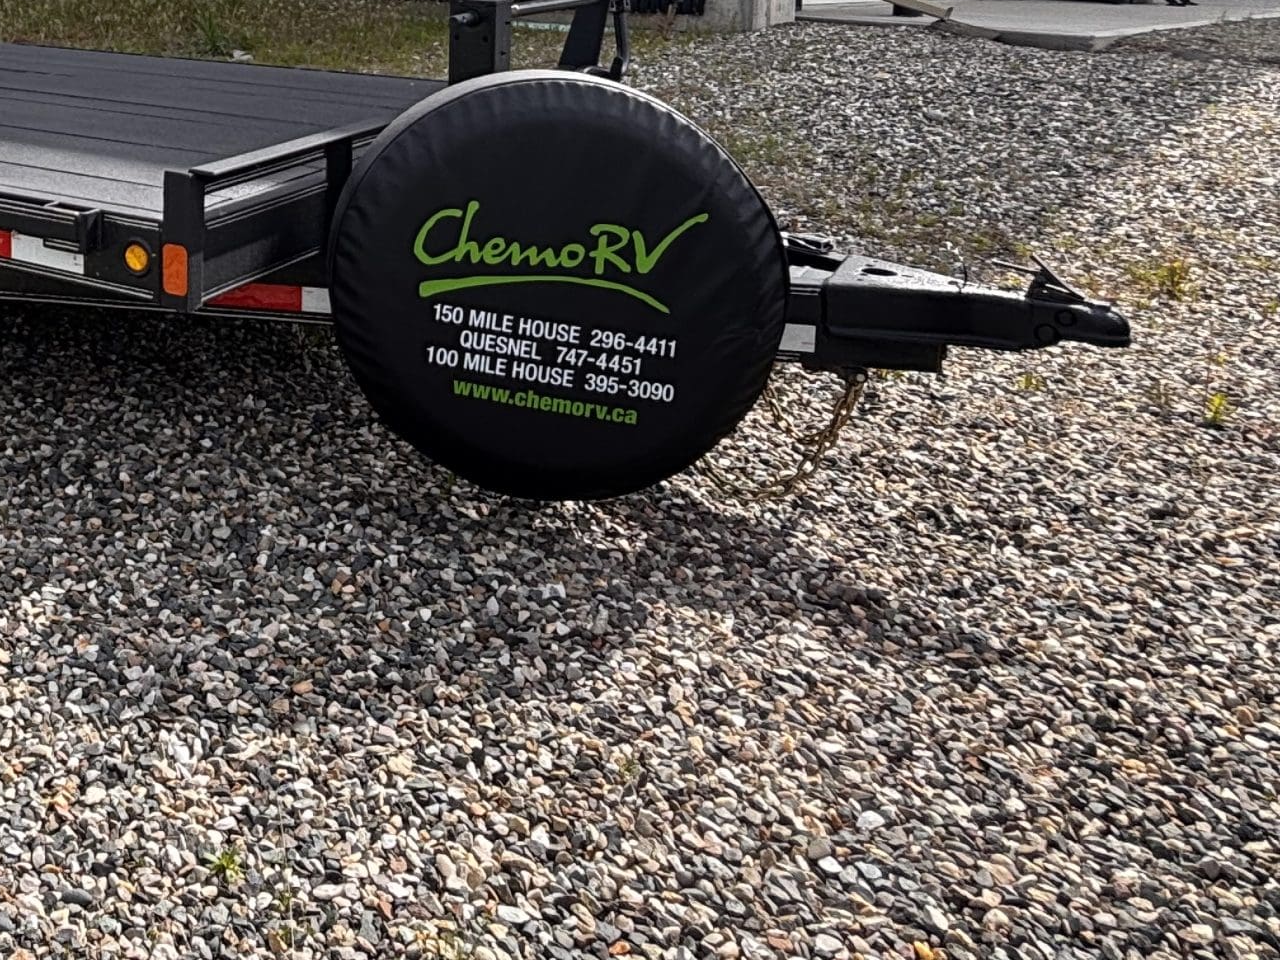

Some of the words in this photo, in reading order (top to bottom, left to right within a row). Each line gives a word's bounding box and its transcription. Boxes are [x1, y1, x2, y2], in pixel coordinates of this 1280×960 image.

[433, 303, 464, 324] 150
[468, 309, 514, 333] MILE
[518, 317, 581, 344] HOUSE
[589, 329, 676, 358] 296-4411
[460, 330, 542, 360] QUESNEL
[556, 346, 641, 375] 747-4451
[426, 346, 459, 367] 100
[463, 352, 507, 376] MILE
[511, 360, 575, 387] HOUSE
[584, 373, 674, 402] 395-3090
[453, 380, 638, 425] www.chemorv.ca
